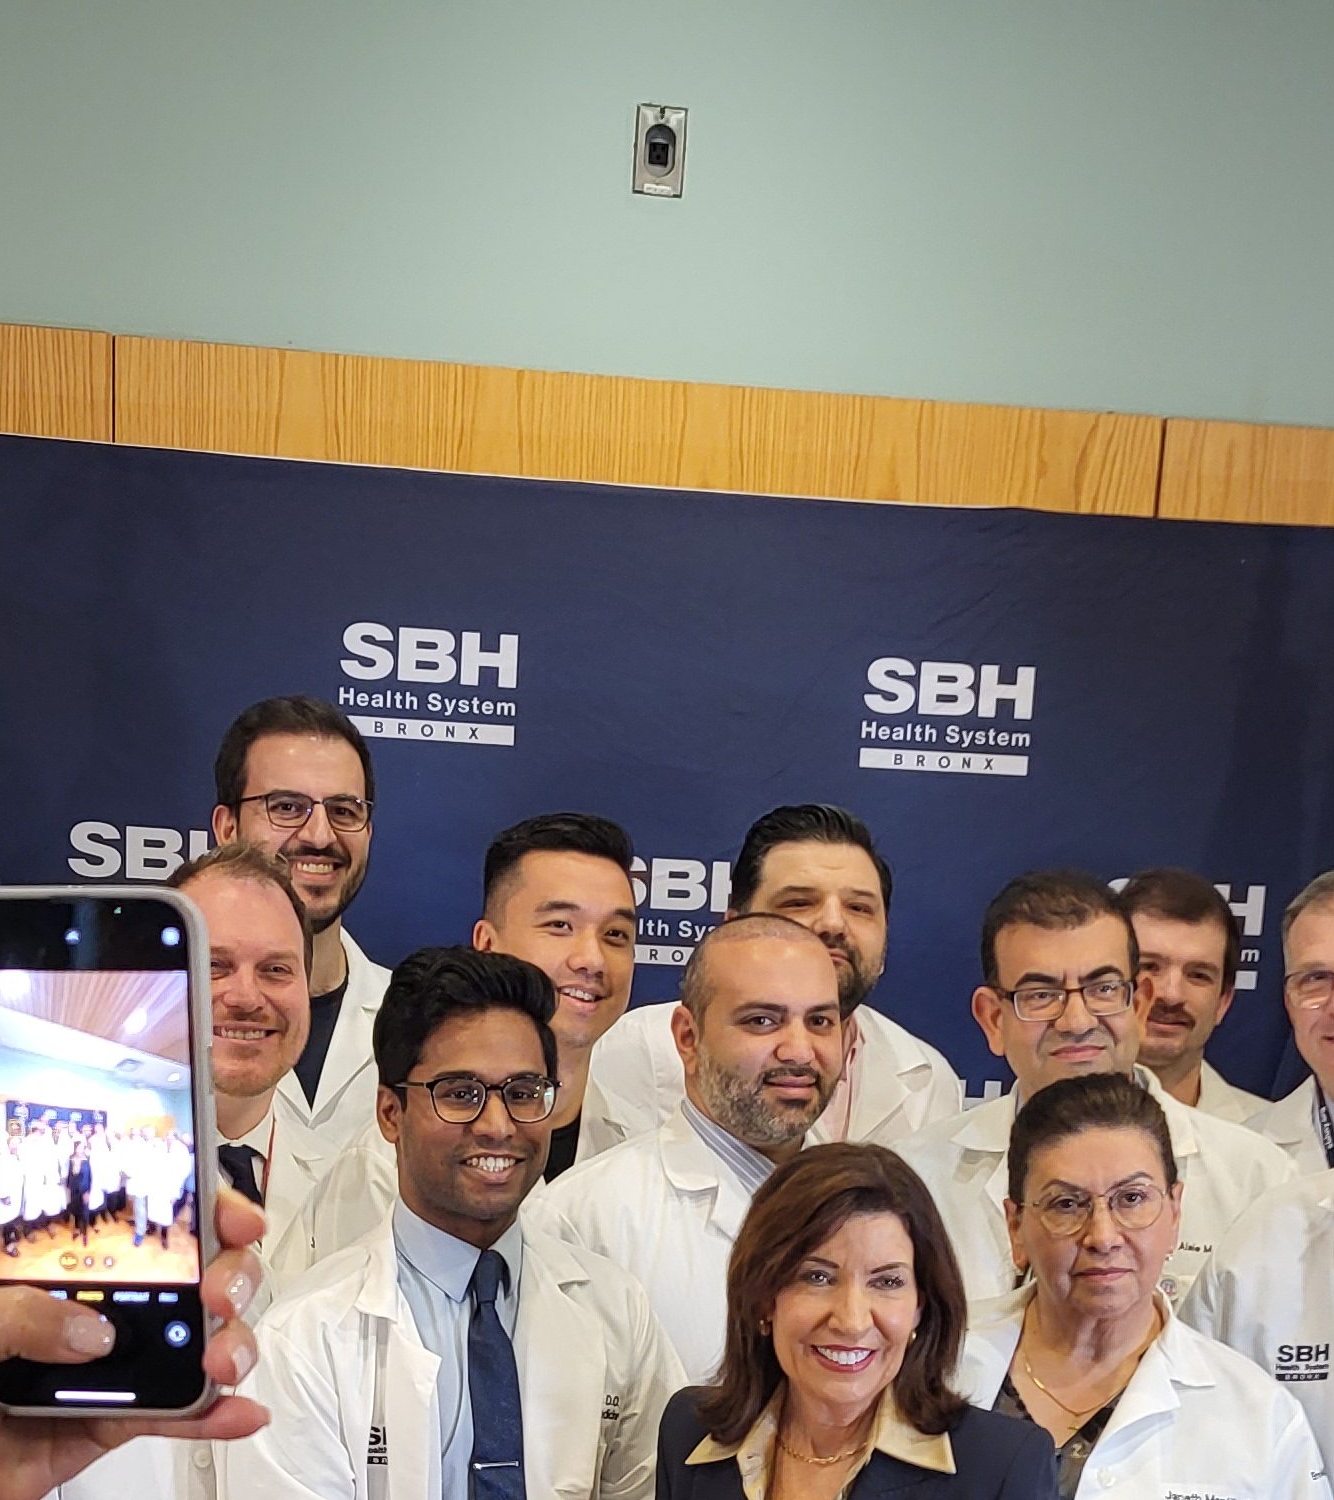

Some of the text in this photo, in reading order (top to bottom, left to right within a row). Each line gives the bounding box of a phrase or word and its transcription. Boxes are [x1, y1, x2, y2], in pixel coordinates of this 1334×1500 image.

[340, 622, 519, 689] SBH
[338, 686, 516, 717] Health System
[863, 657, 1037, 720] SBH
[374, 721, 479, 740] BRONX
[861, 720, 1030, 748] Health System
[893, 753, 994, 771] BRONX
[638, 917, 716, 942] lth Sys
[1276, 1343, 1330, 1363] SBH
